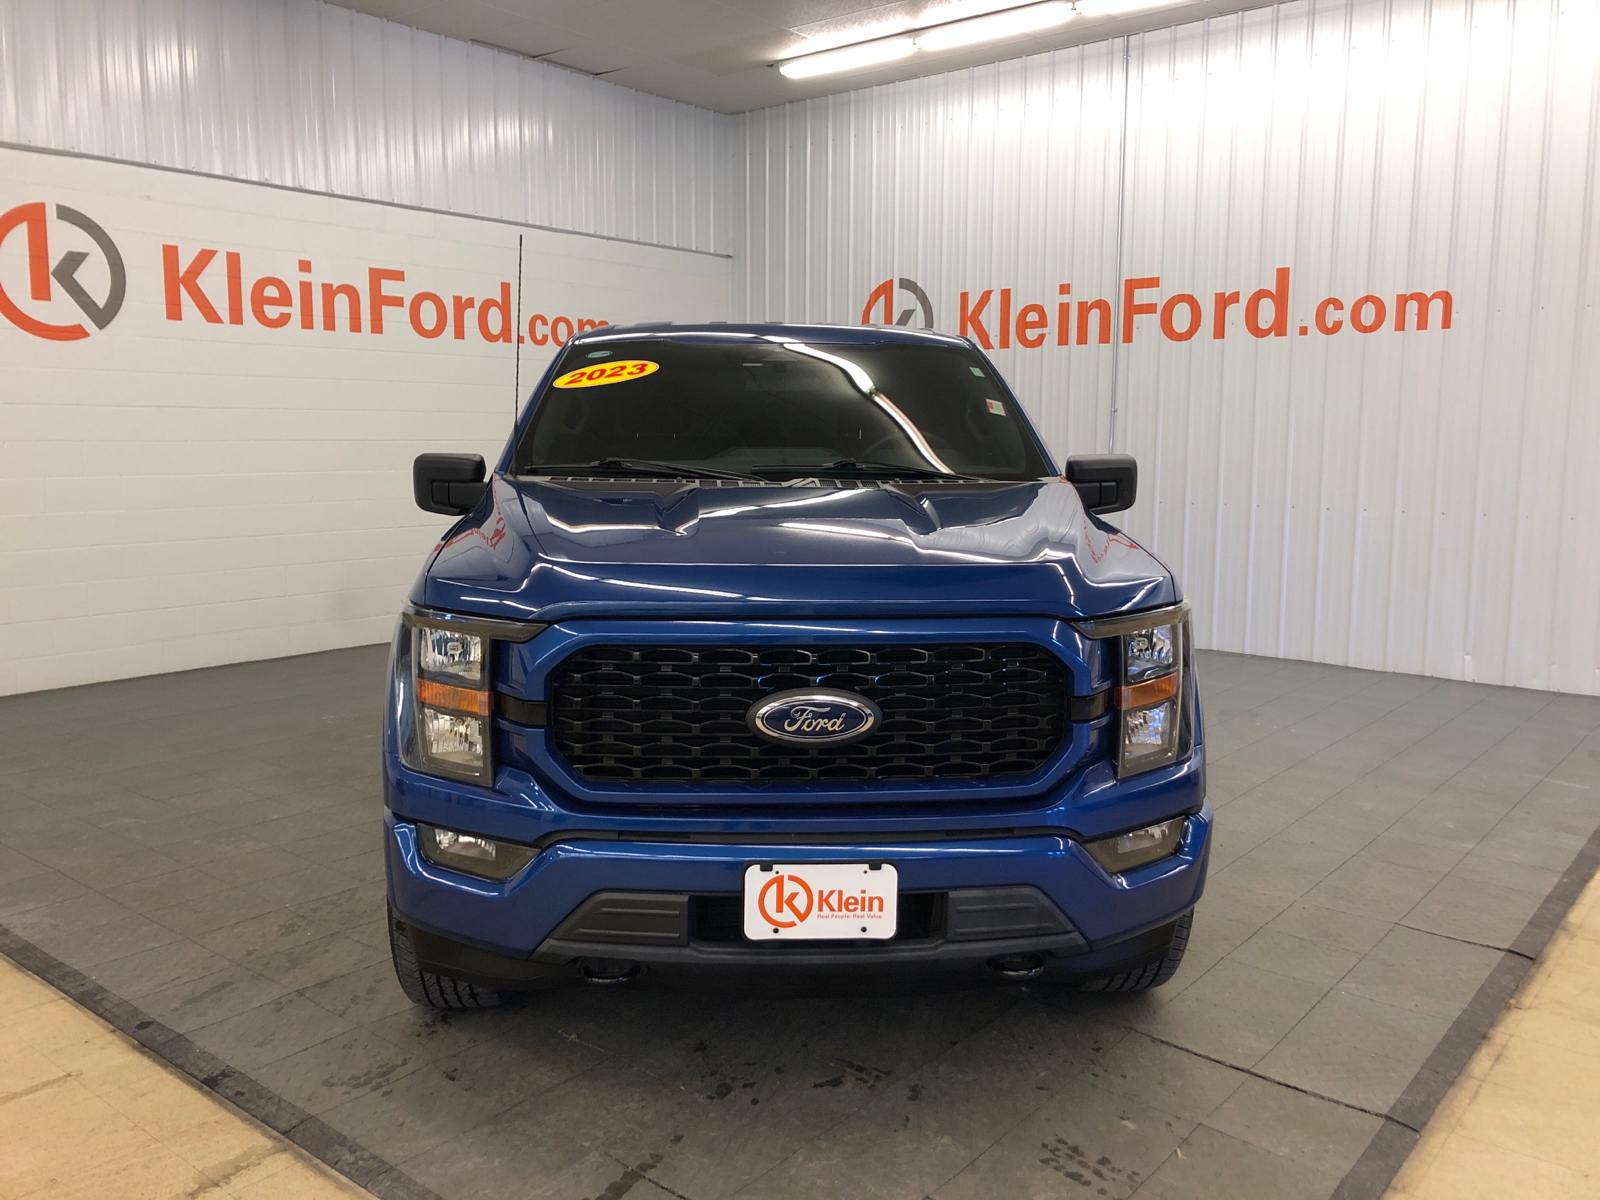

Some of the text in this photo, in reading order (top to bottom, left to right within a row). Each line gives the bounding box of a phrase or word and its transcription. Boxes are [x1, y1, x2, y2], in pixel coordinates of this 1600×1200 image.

[959, 266, 1453, 351] KleinFord.com
[563, 362, 649, 386] 2023
[783, 705, 847, 732] Ford
[817, 889, 884, 913] Klein
